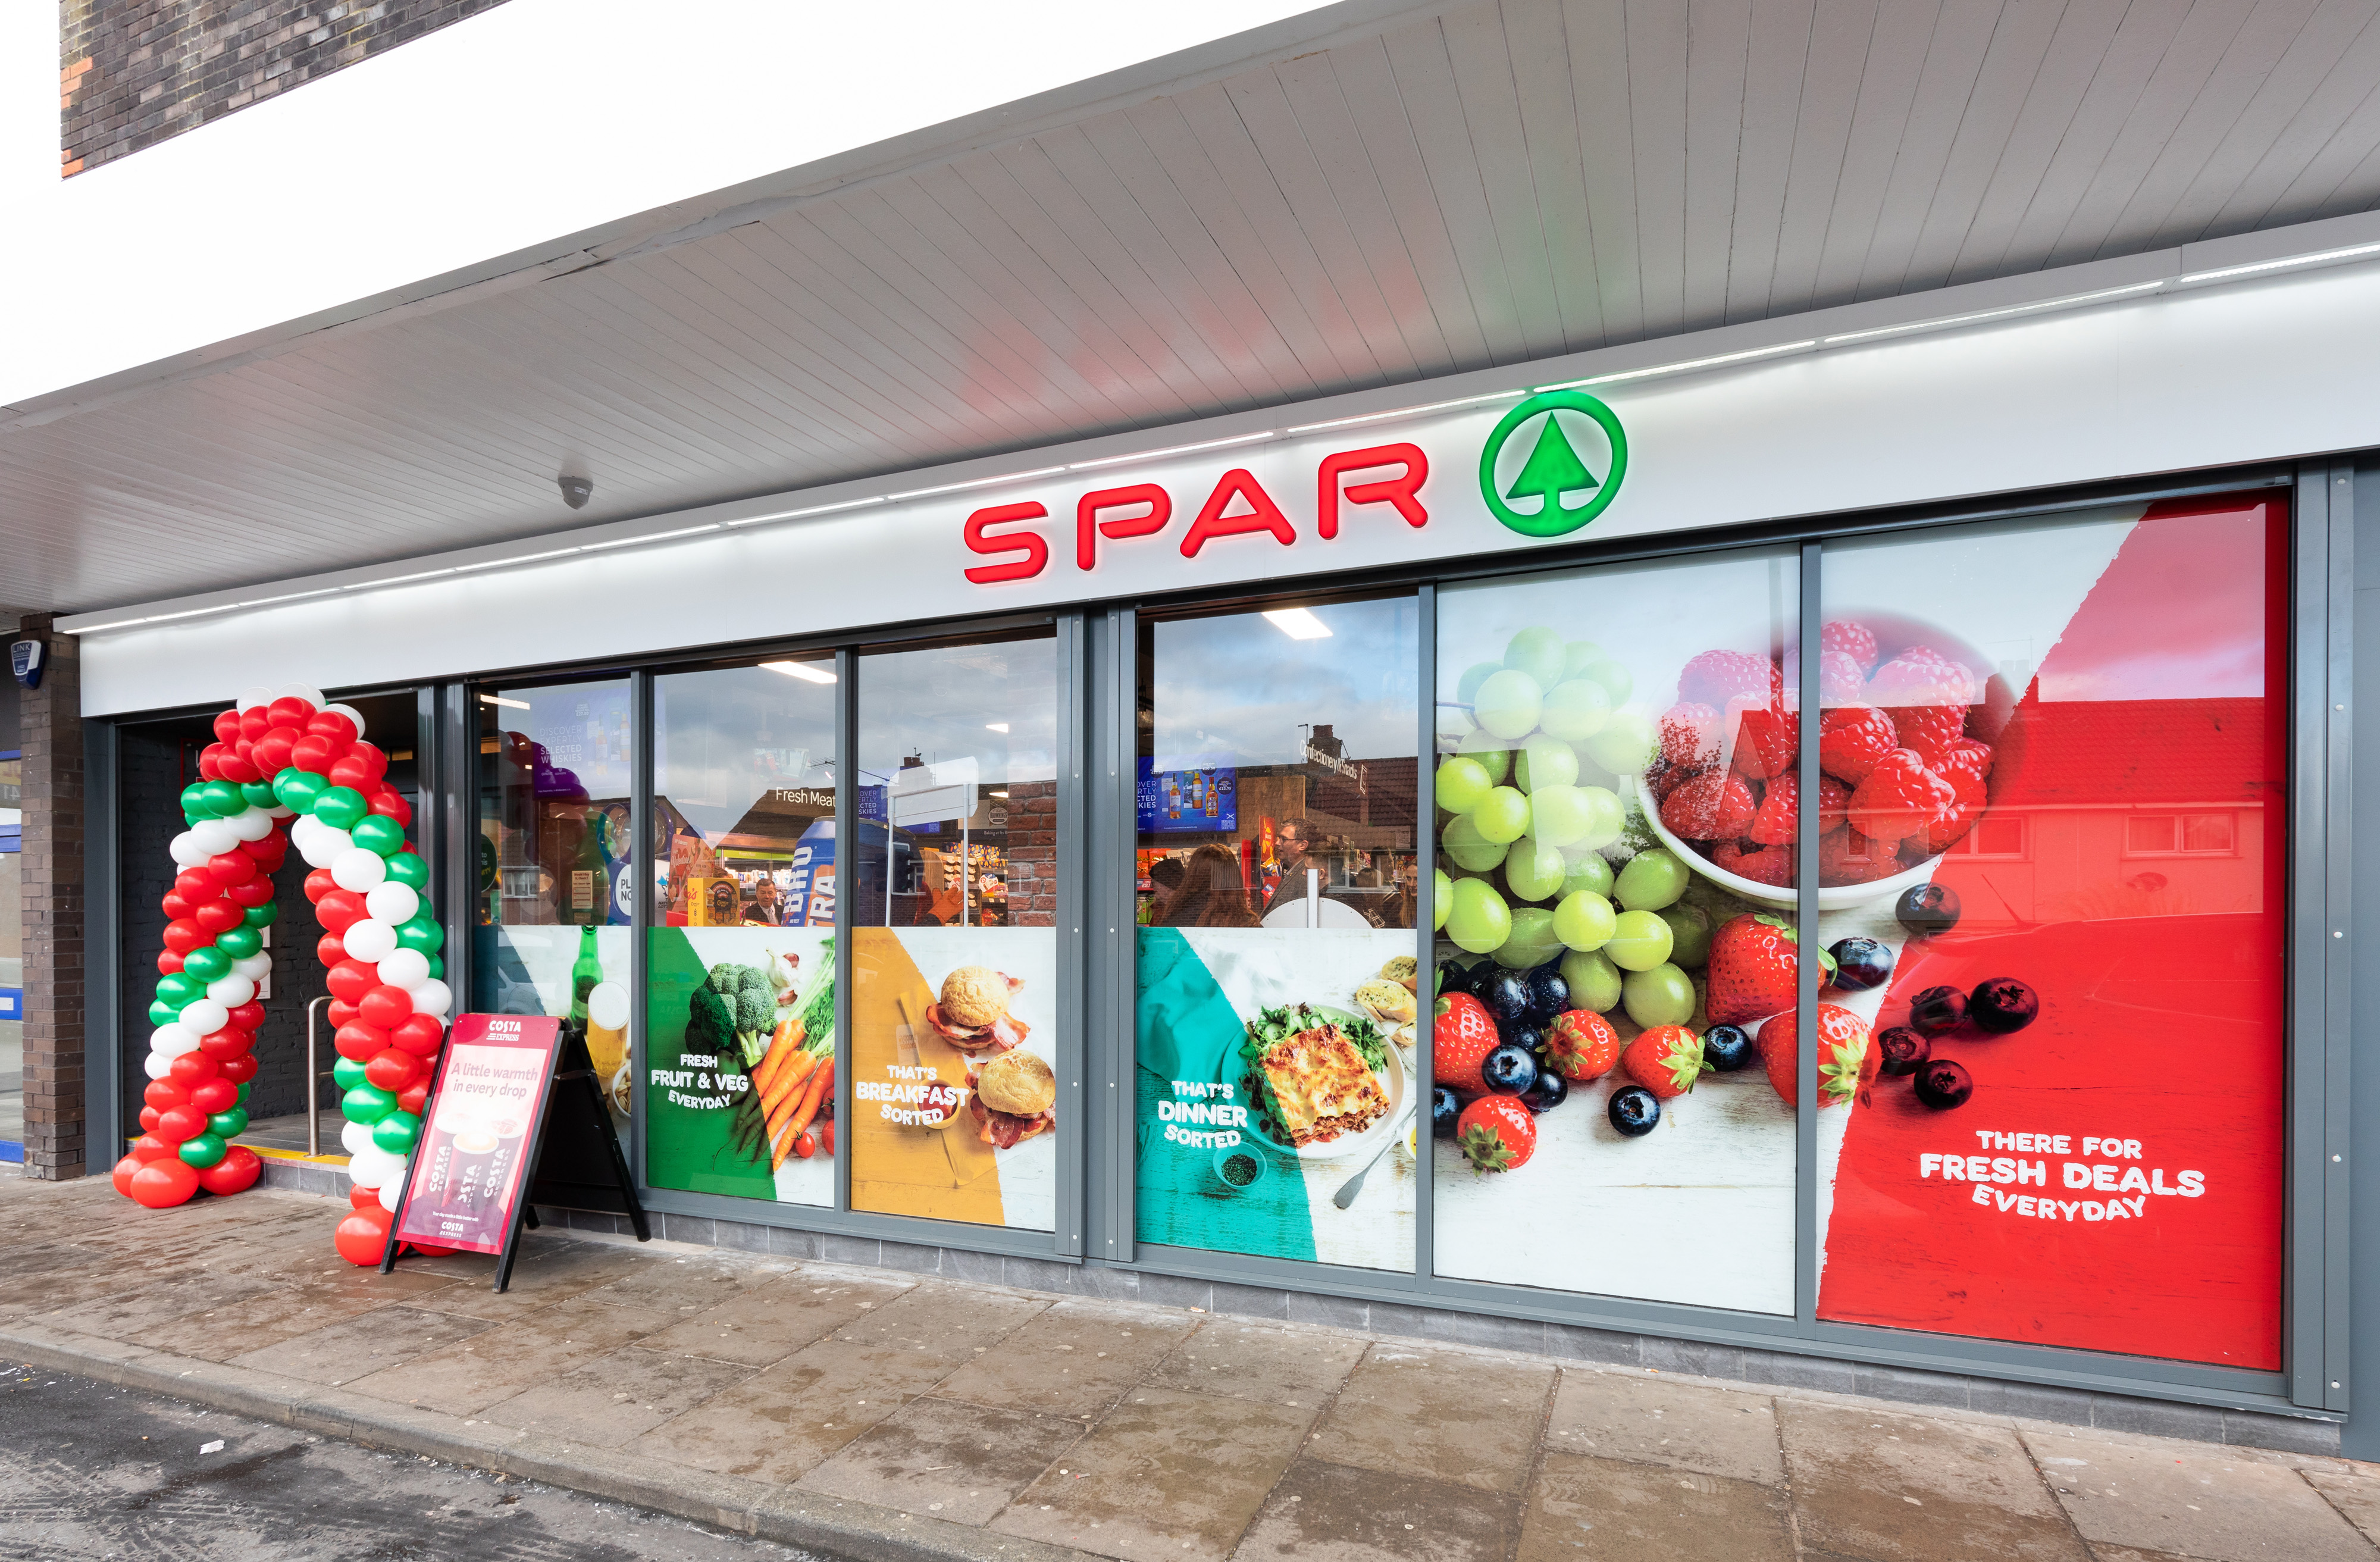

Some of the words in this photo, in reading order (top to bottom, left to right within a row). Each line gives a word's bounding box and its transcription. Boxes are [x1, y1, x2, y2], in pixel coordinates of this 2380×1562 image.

[964, 442, 1428, 585] SPAR
[13, 643, 30, 653] LINK
[540, 725, 582, 736] DISCOVER
[540, 735, 582, 745] EXPERTLY
[540, 744, 582, 755] SELECTED
[541, 754, 582, 764] WHISKIES
[1300, 740, 1337, 774] Confectionery
[1337, 757, 1342, 773] &
[1341, 760, 1357, 780] Snacks
[776, 787, 808, 803] Fresh
[810, 791, 835, 807] Meat
[783, 846, 813, 913] BRU
[489, 1020, 521, 1033] COSTA
[496, 1033, 519, 1041] EXPRESS
[680, 1054, 718, 1068] FRESH
[451, 1063, 460, 1075] A
[463, 1063, 490, 1077] little
[493, 1068, 538, 1081] warmth
[651, 1069, 694, 1088] FRUIT
[697, 1072, 710, 1089] &
[715, 1073, 749, 1092] VEG
[887, 1065, 938, 1081] THAT'S
[453, 1079, 464, 1092] in
[465, 1083, 497, 1097] every
[499, 1083, 527, 1100] drop
[668, 1090, 731, 1109] EVERYDAY
[856, 1081, 970, 1107] BREAKFAST
[1171, 1081, 1234, 1099] THAT'S
[880, 1104, 944, 1126] SORTED
[1158, 1100, 1248, 1128] DINNER
[1164, 1124, 1241, 1148] SORTED
[1975, 1130, 2072, 1154] THERE
[2082, 1137, 2143, 1160] FOR
[429, 1146, 447, 1192] COSTA
[439, 1147, 451, 1187] EXPRESS
[484, 1148, 506, 1198] COSTA
[1920, 1153, 2046, 1187] FRESH
[2063, 1162, 2205, 1198] DEALS
[1972, 1184, 2146, 1222] EVERYDAY
[441, 1221, 464, 1232] COSTA
